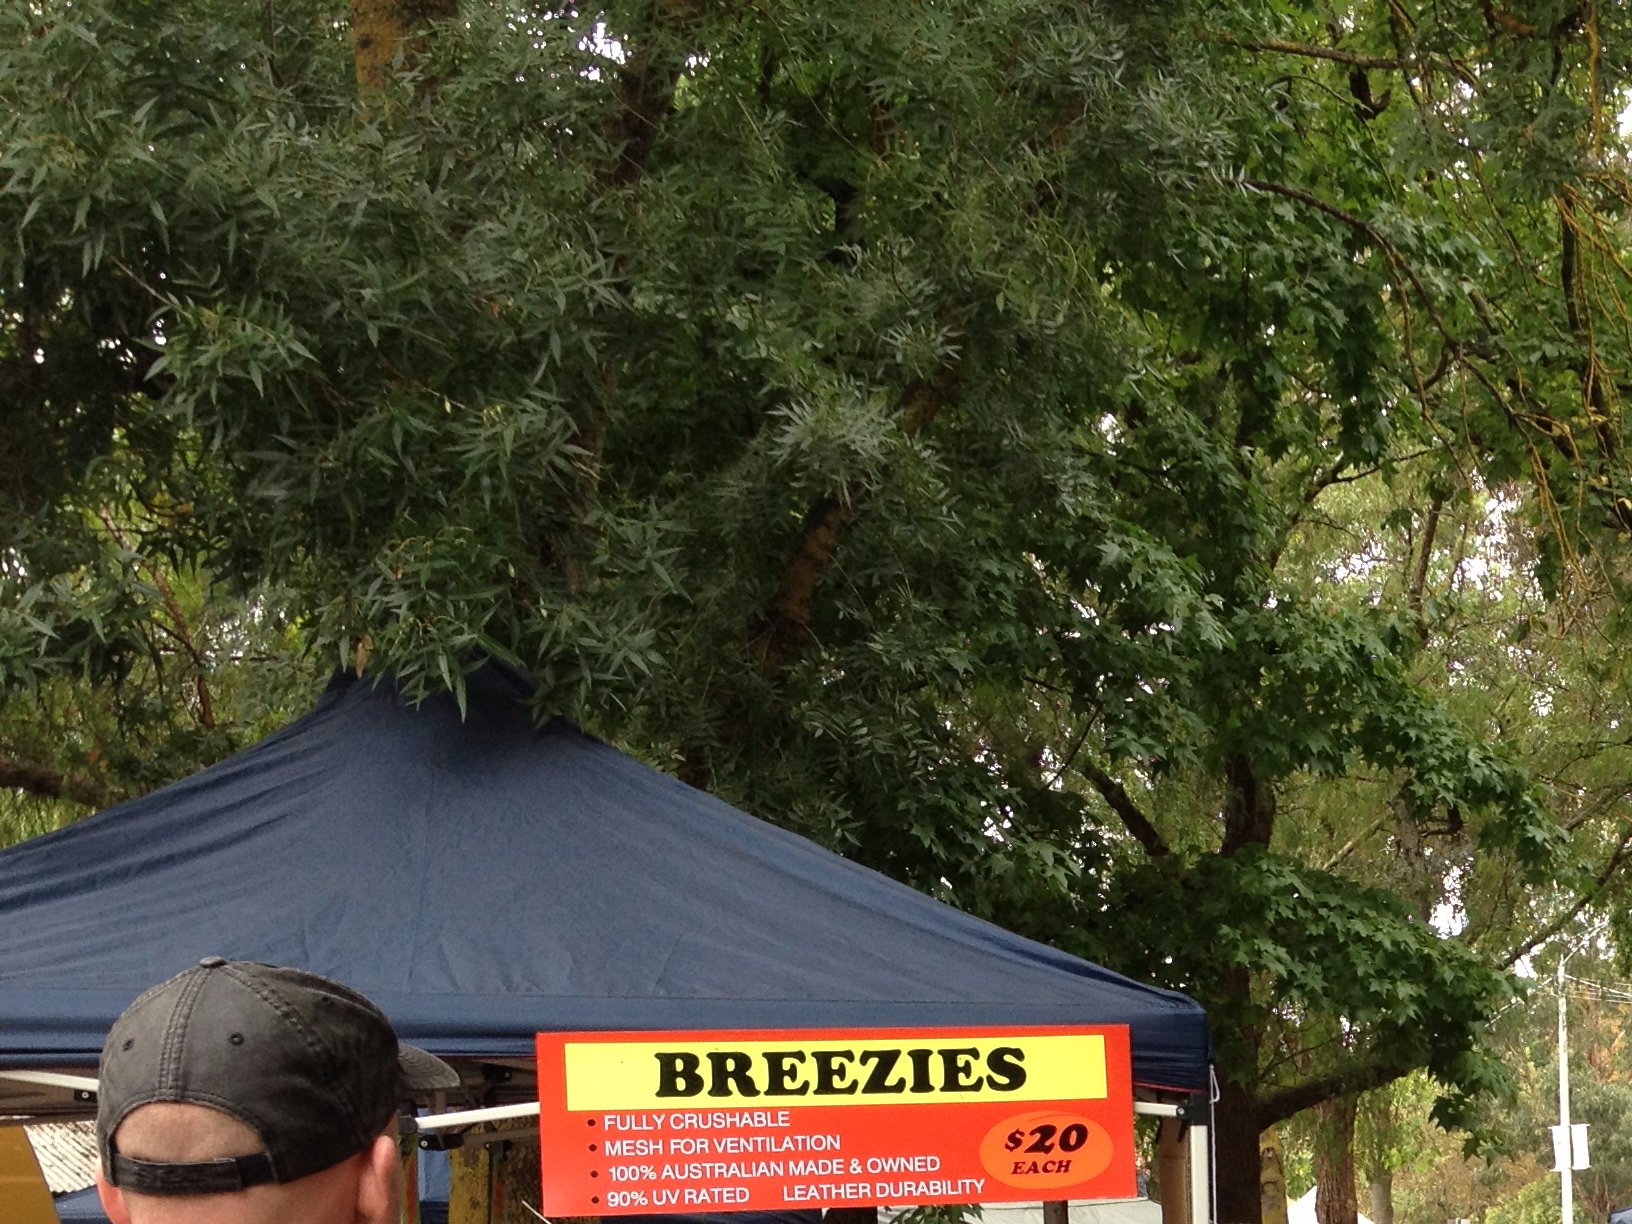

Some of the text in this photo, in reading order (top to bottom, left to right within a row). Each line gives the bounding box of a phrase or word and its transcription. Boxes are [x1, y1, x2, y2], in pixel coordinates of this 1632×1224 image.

[654, 1047, 1027, 1097] BREEZIES
[604, 1111, 790, 1130] FULLY CRUSHABLE
[605, 1134, 840, 1156] MESH FOR VENTILATION
[1004, 1123, 1088, 1155] $20
[609, 1156, 940, 1181] 100% AUSTRALIAN MADE & OWNED
[1011, 1160, 1073, 1175] EACH
[607, 1179, 985, 1207] 90% UV RATED LEATHER DURABILITY
